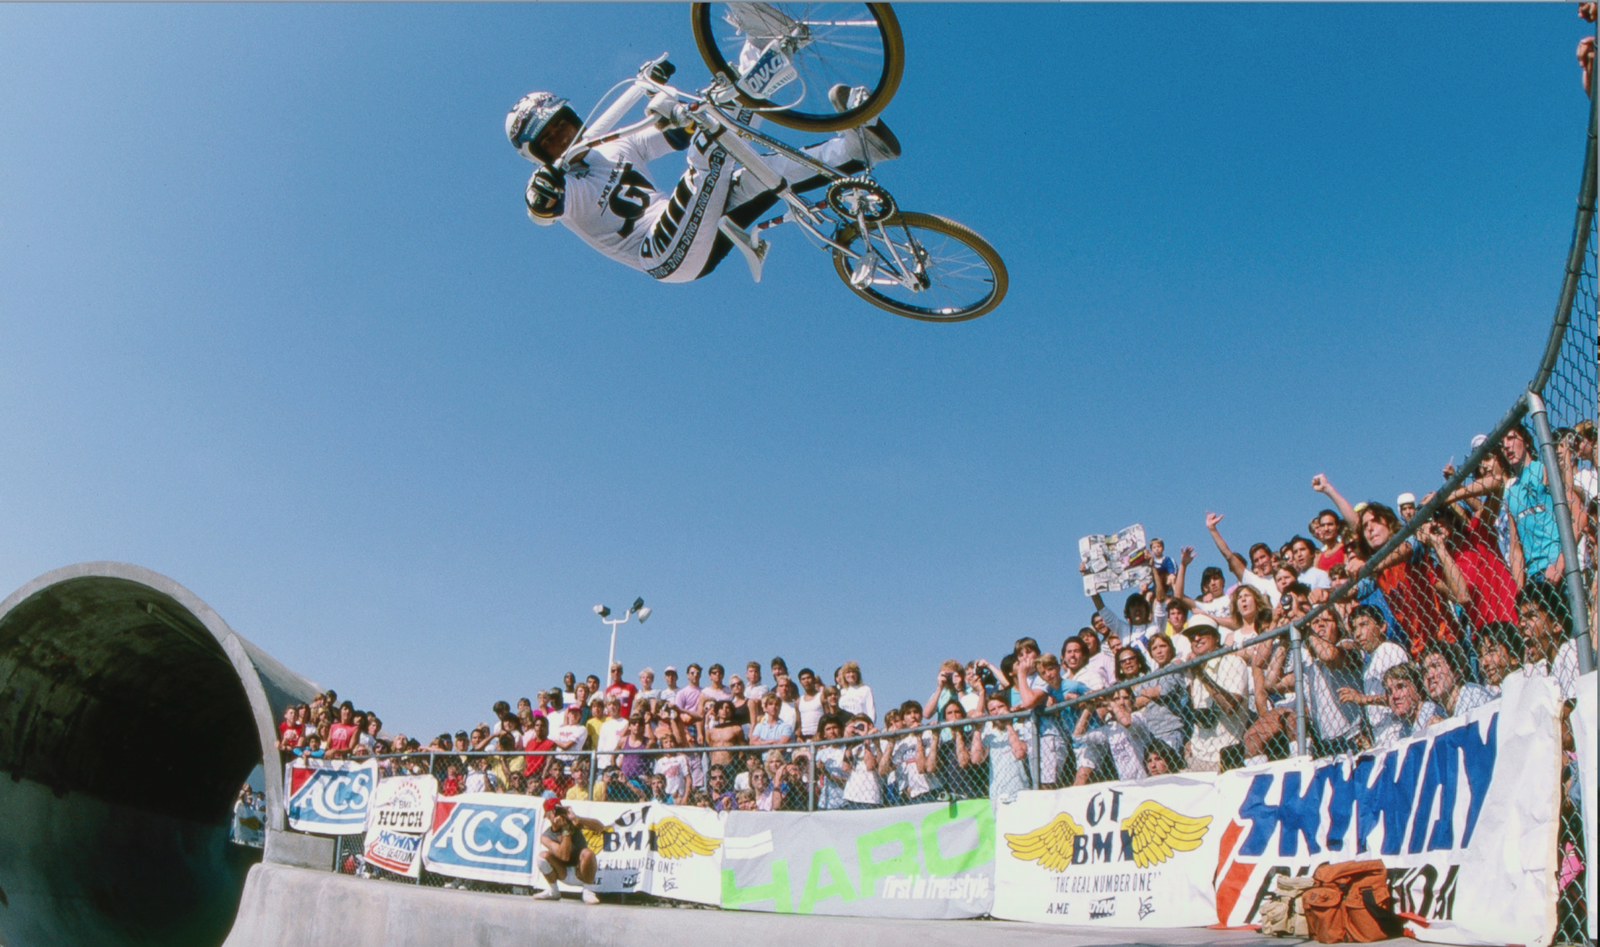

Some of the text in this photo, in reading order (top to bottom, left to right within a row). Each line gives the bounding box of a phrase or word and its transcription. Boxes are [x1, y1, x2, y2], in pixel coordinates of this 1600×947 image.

[747, 53, 783, 93] DYNO
[669, 247, 685, 270] DYNO
[682, 221, 698, 245] DYNO
[694, 191, 710, 217] DYNO
[294, 772, 371, 820] ACS
[1238, 711, 1499, 858] SKYWAY
[378, 810, 424, 828] HUTCH
[1086, 788, 1123, 828] GT
[434, 807, 531, 867] ACS
[721, 798, 996, 915] HARO
[1071, 829, 1137, 865] BMX
[882, 874, 913, 900] first
[926, 873, 990, 904] freestyle
[1071, 875, 1091, 893] REAL
[1092, 873, 1131, 893] NUMBER
